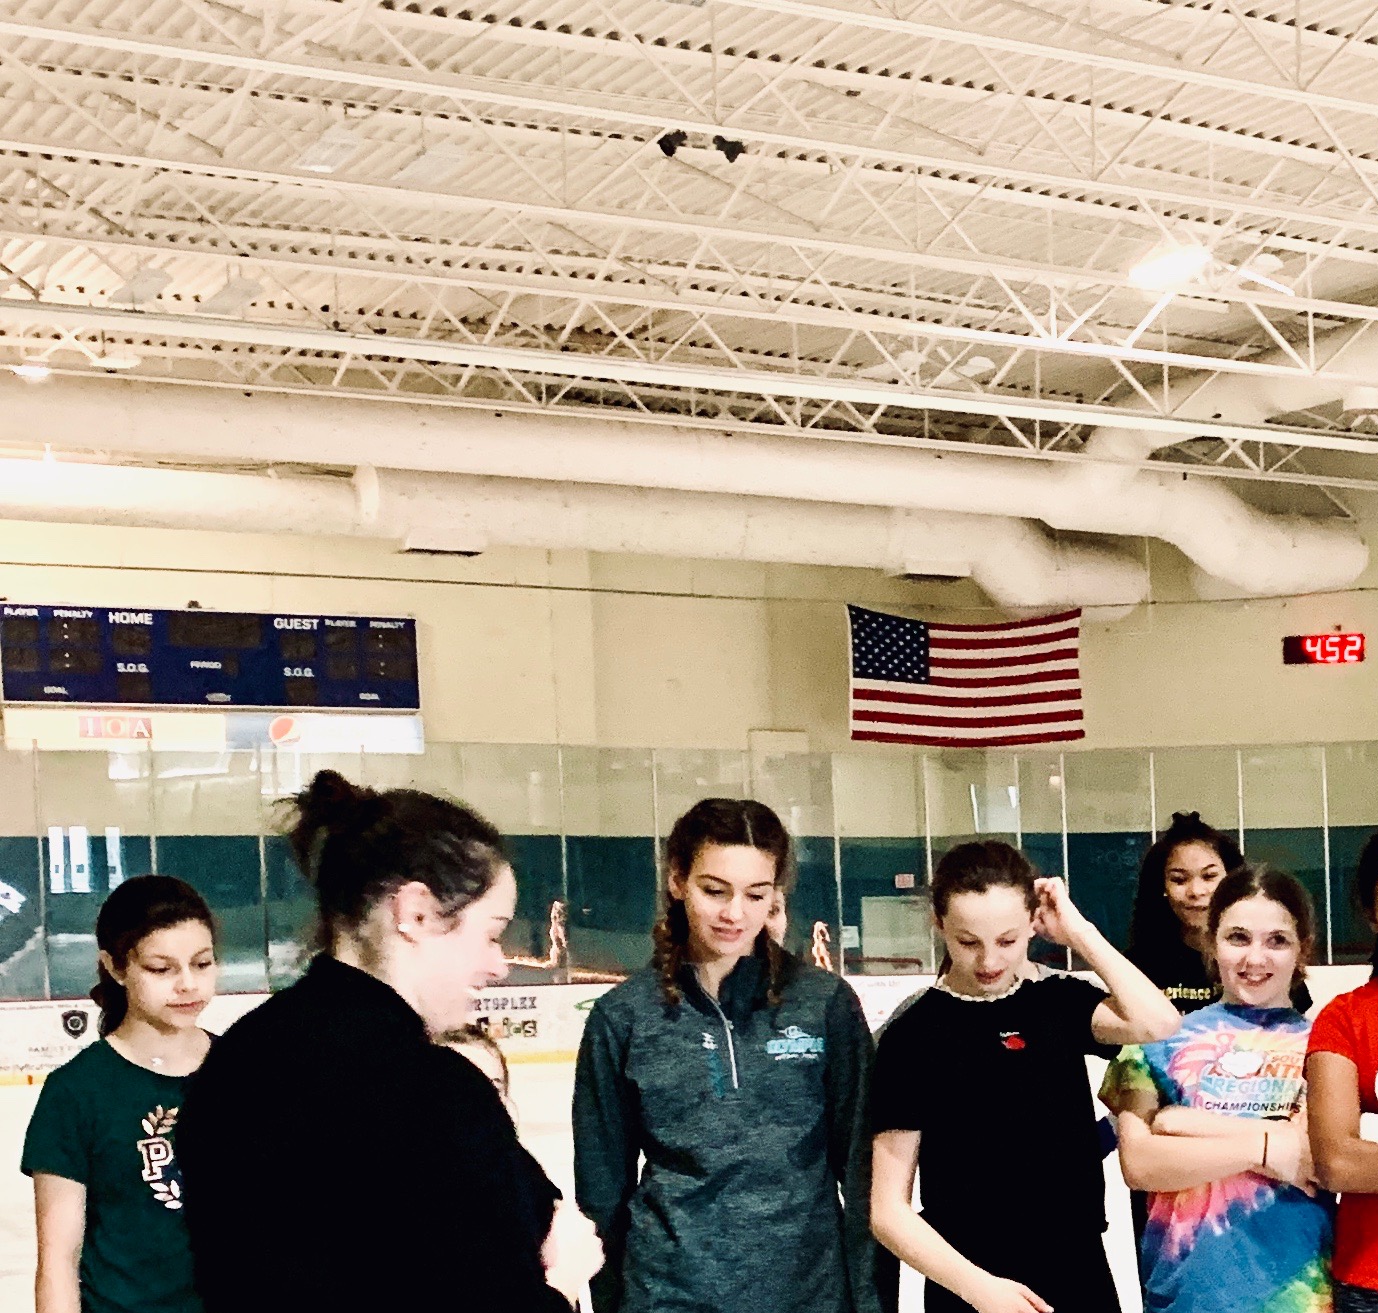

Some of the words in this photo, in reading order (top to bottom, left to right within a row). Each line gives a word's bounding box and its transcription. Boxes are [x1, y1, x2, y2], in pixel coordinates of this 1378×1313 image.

[108, 612, 154, 625] HOME
[274, 618, 319, 630] GUEST
[1164, 983, 1211, 1001] erience
[1212, 1078, 1305, 1094] REGIONA
[137, 1136, 174, 1182] P
